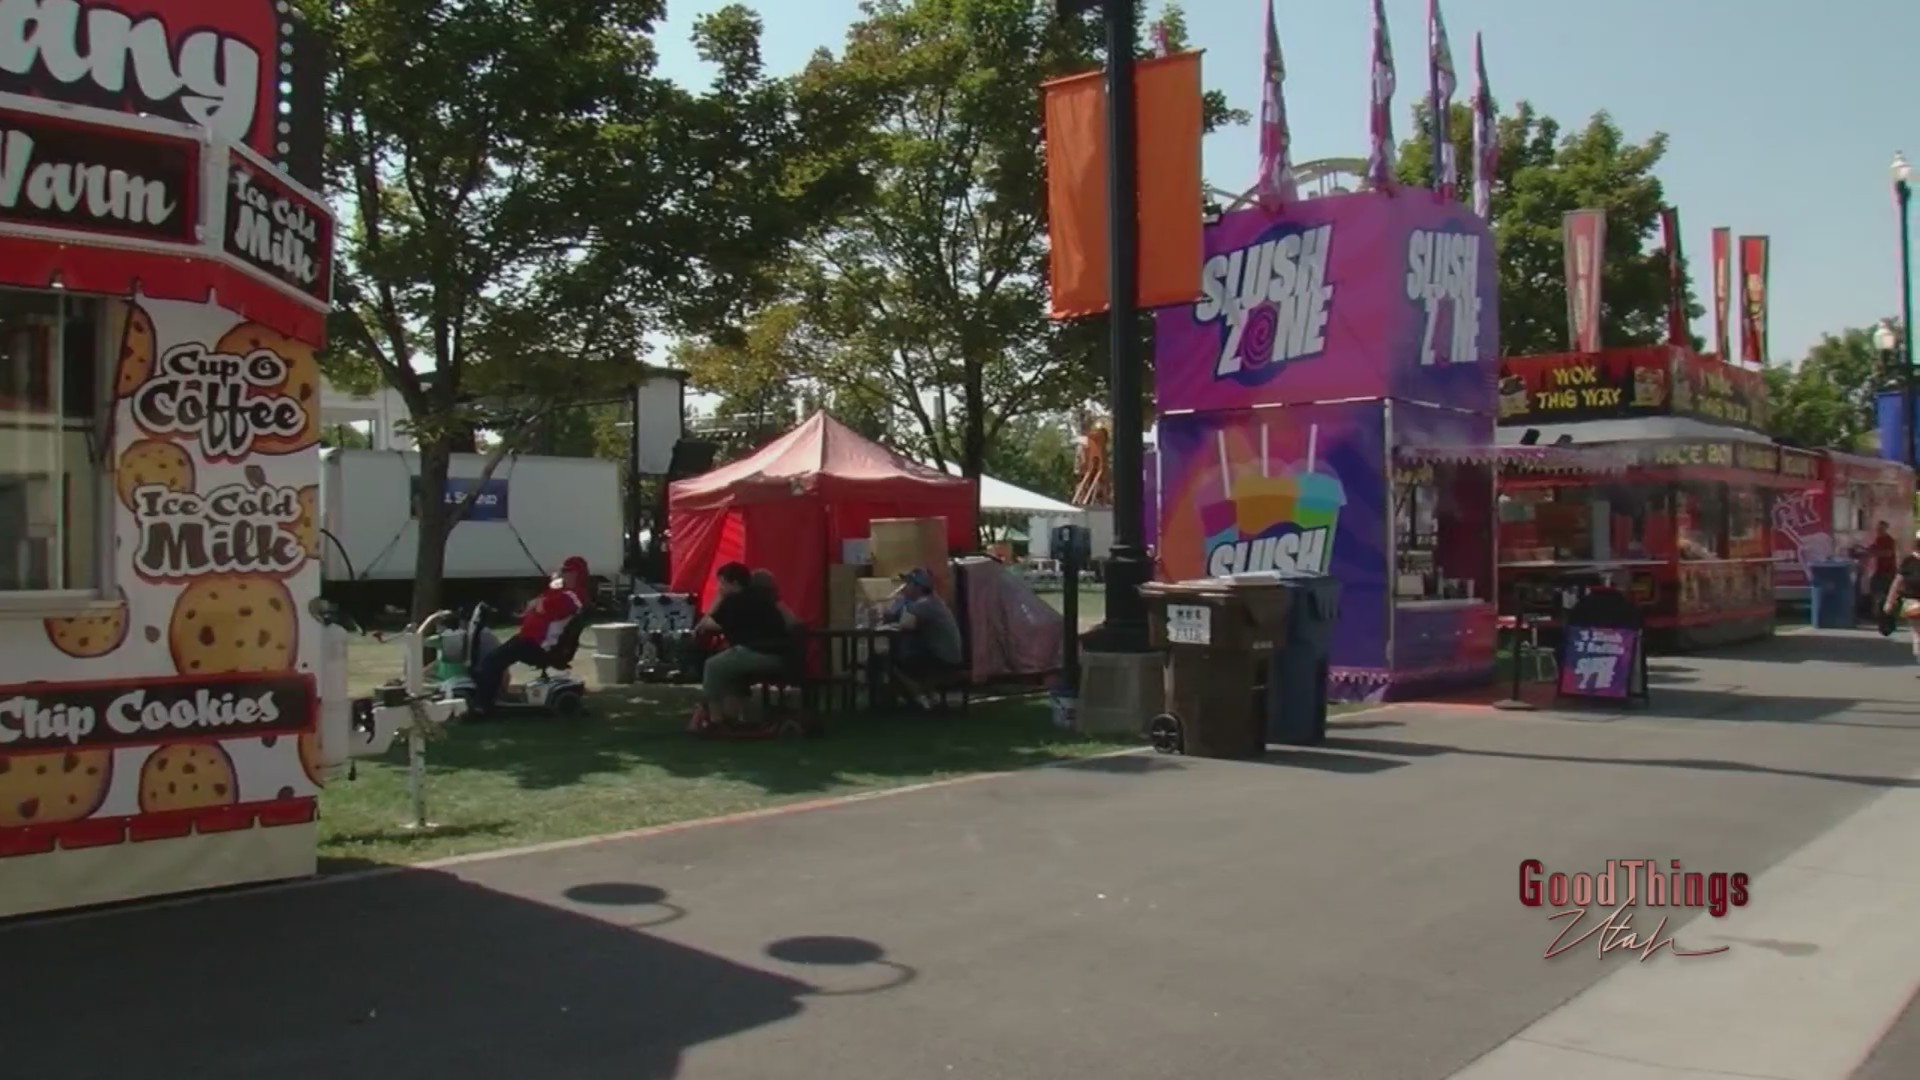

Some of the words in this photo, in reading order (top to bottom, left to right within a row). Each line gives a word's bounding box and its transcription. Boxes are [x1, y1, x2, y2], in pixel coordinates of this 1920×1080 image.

[235, 170, 268, 212] Ice
[272, 199, 316, 242] Cold
[234, 204, 320, 284] Milk
[1407, 229, 1480, 300] SLUSH
[1195, 225, 1333, 322] SLUSH
[167, 351, 239, 385] Cup
[1552, 365, 1597, 385] WOK
[140, 381, 300, 449] Coffee
[1536, 388, 1577, 409] THIS
[1581, 387, 1622, 406] WAY
[142, 491, 199, 516] Ice
[210, 490, 295, 517] Cold
[142, 519, 303, 571] Milk
[0, 696, 95, 744] Chip
[106, 689, 280, 734] Cookies
